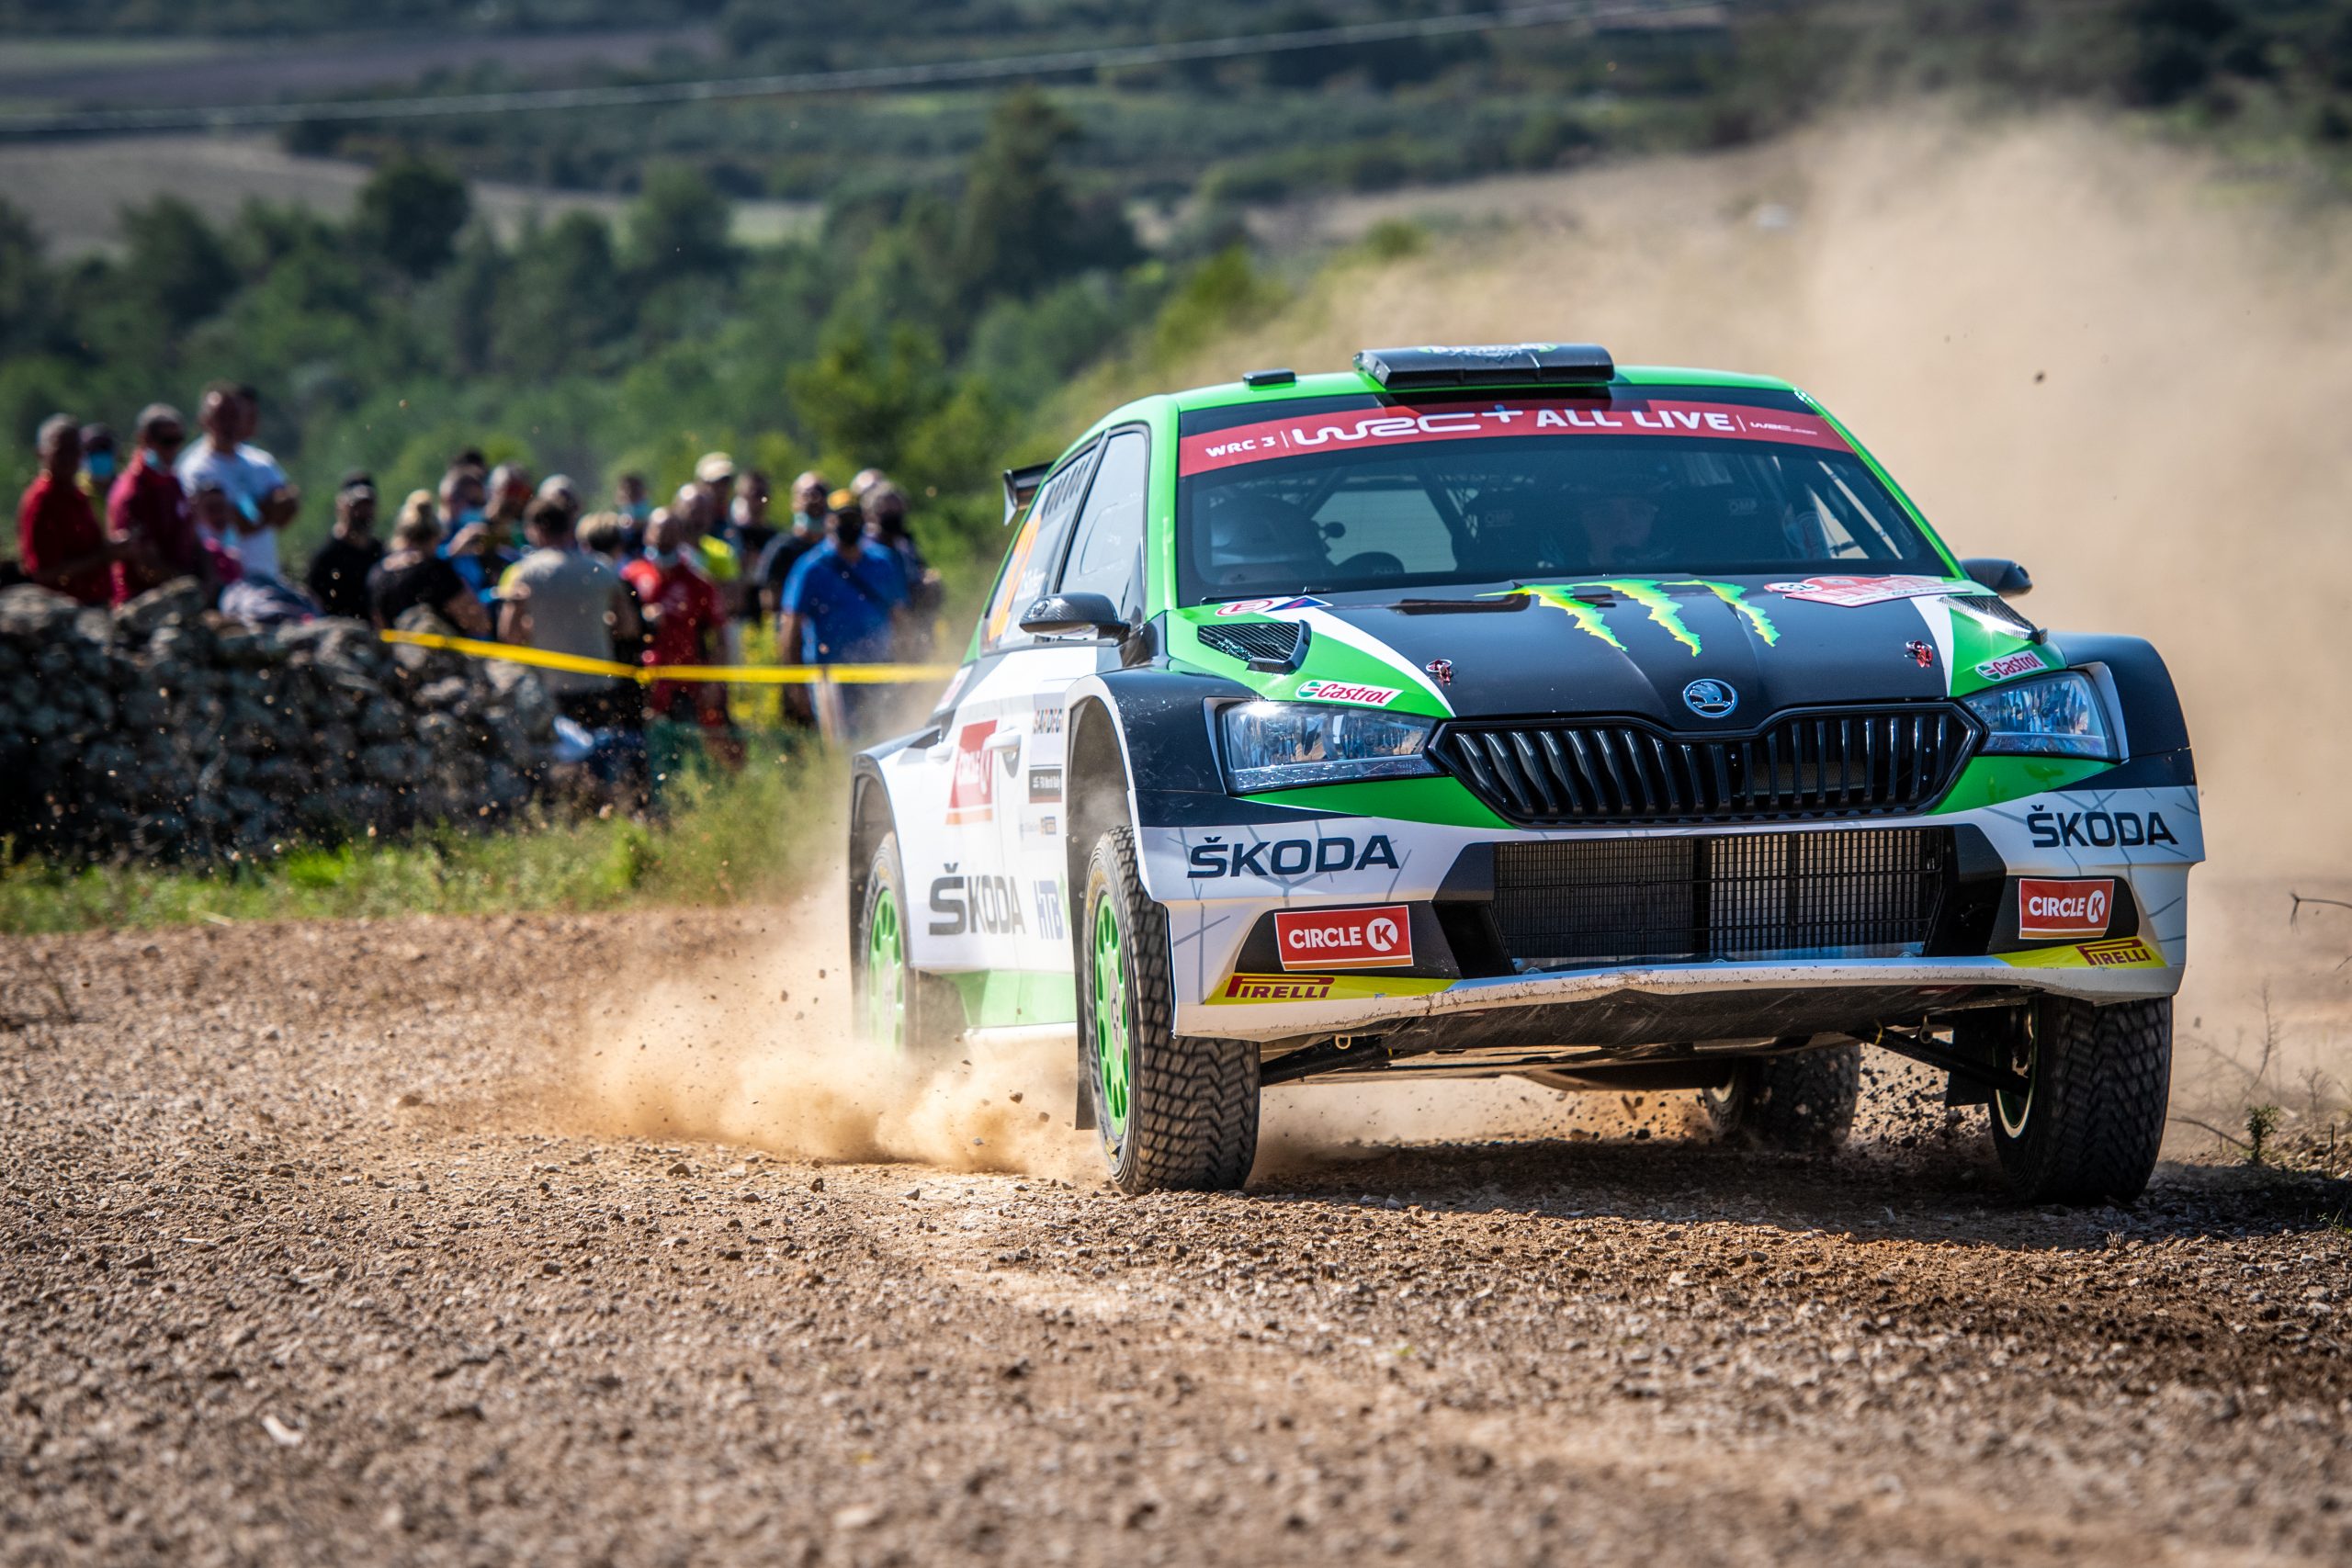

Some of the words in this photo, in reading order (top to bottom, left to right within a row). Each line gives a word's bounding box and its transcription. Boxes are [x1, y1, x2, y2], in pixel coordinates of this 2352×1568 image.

[1205, 439, 1257, 457] WRC
[1261, 435, 1276, 448] 3
[1536, 408, 1623, 428] ALL
[1631, 410, 1736, 432] LIVE
[1992, 653, 2044, 677] Castrol
[1317, 683, 1393, 705] Castrol
[2027, 805, 2179, 848] ŠKODA
[1187, 835, 1399, 879] ŠKODA
[929, 862, 1026, 937] ŠKODA
[2028, 896, 2086, 918] CIRCLE
[1288, 926, 1363, 949] CIRCLE
[2075, 939, 2152, 965] PIRELLI
[1225, 976, 1335, 998] PIRELLI
